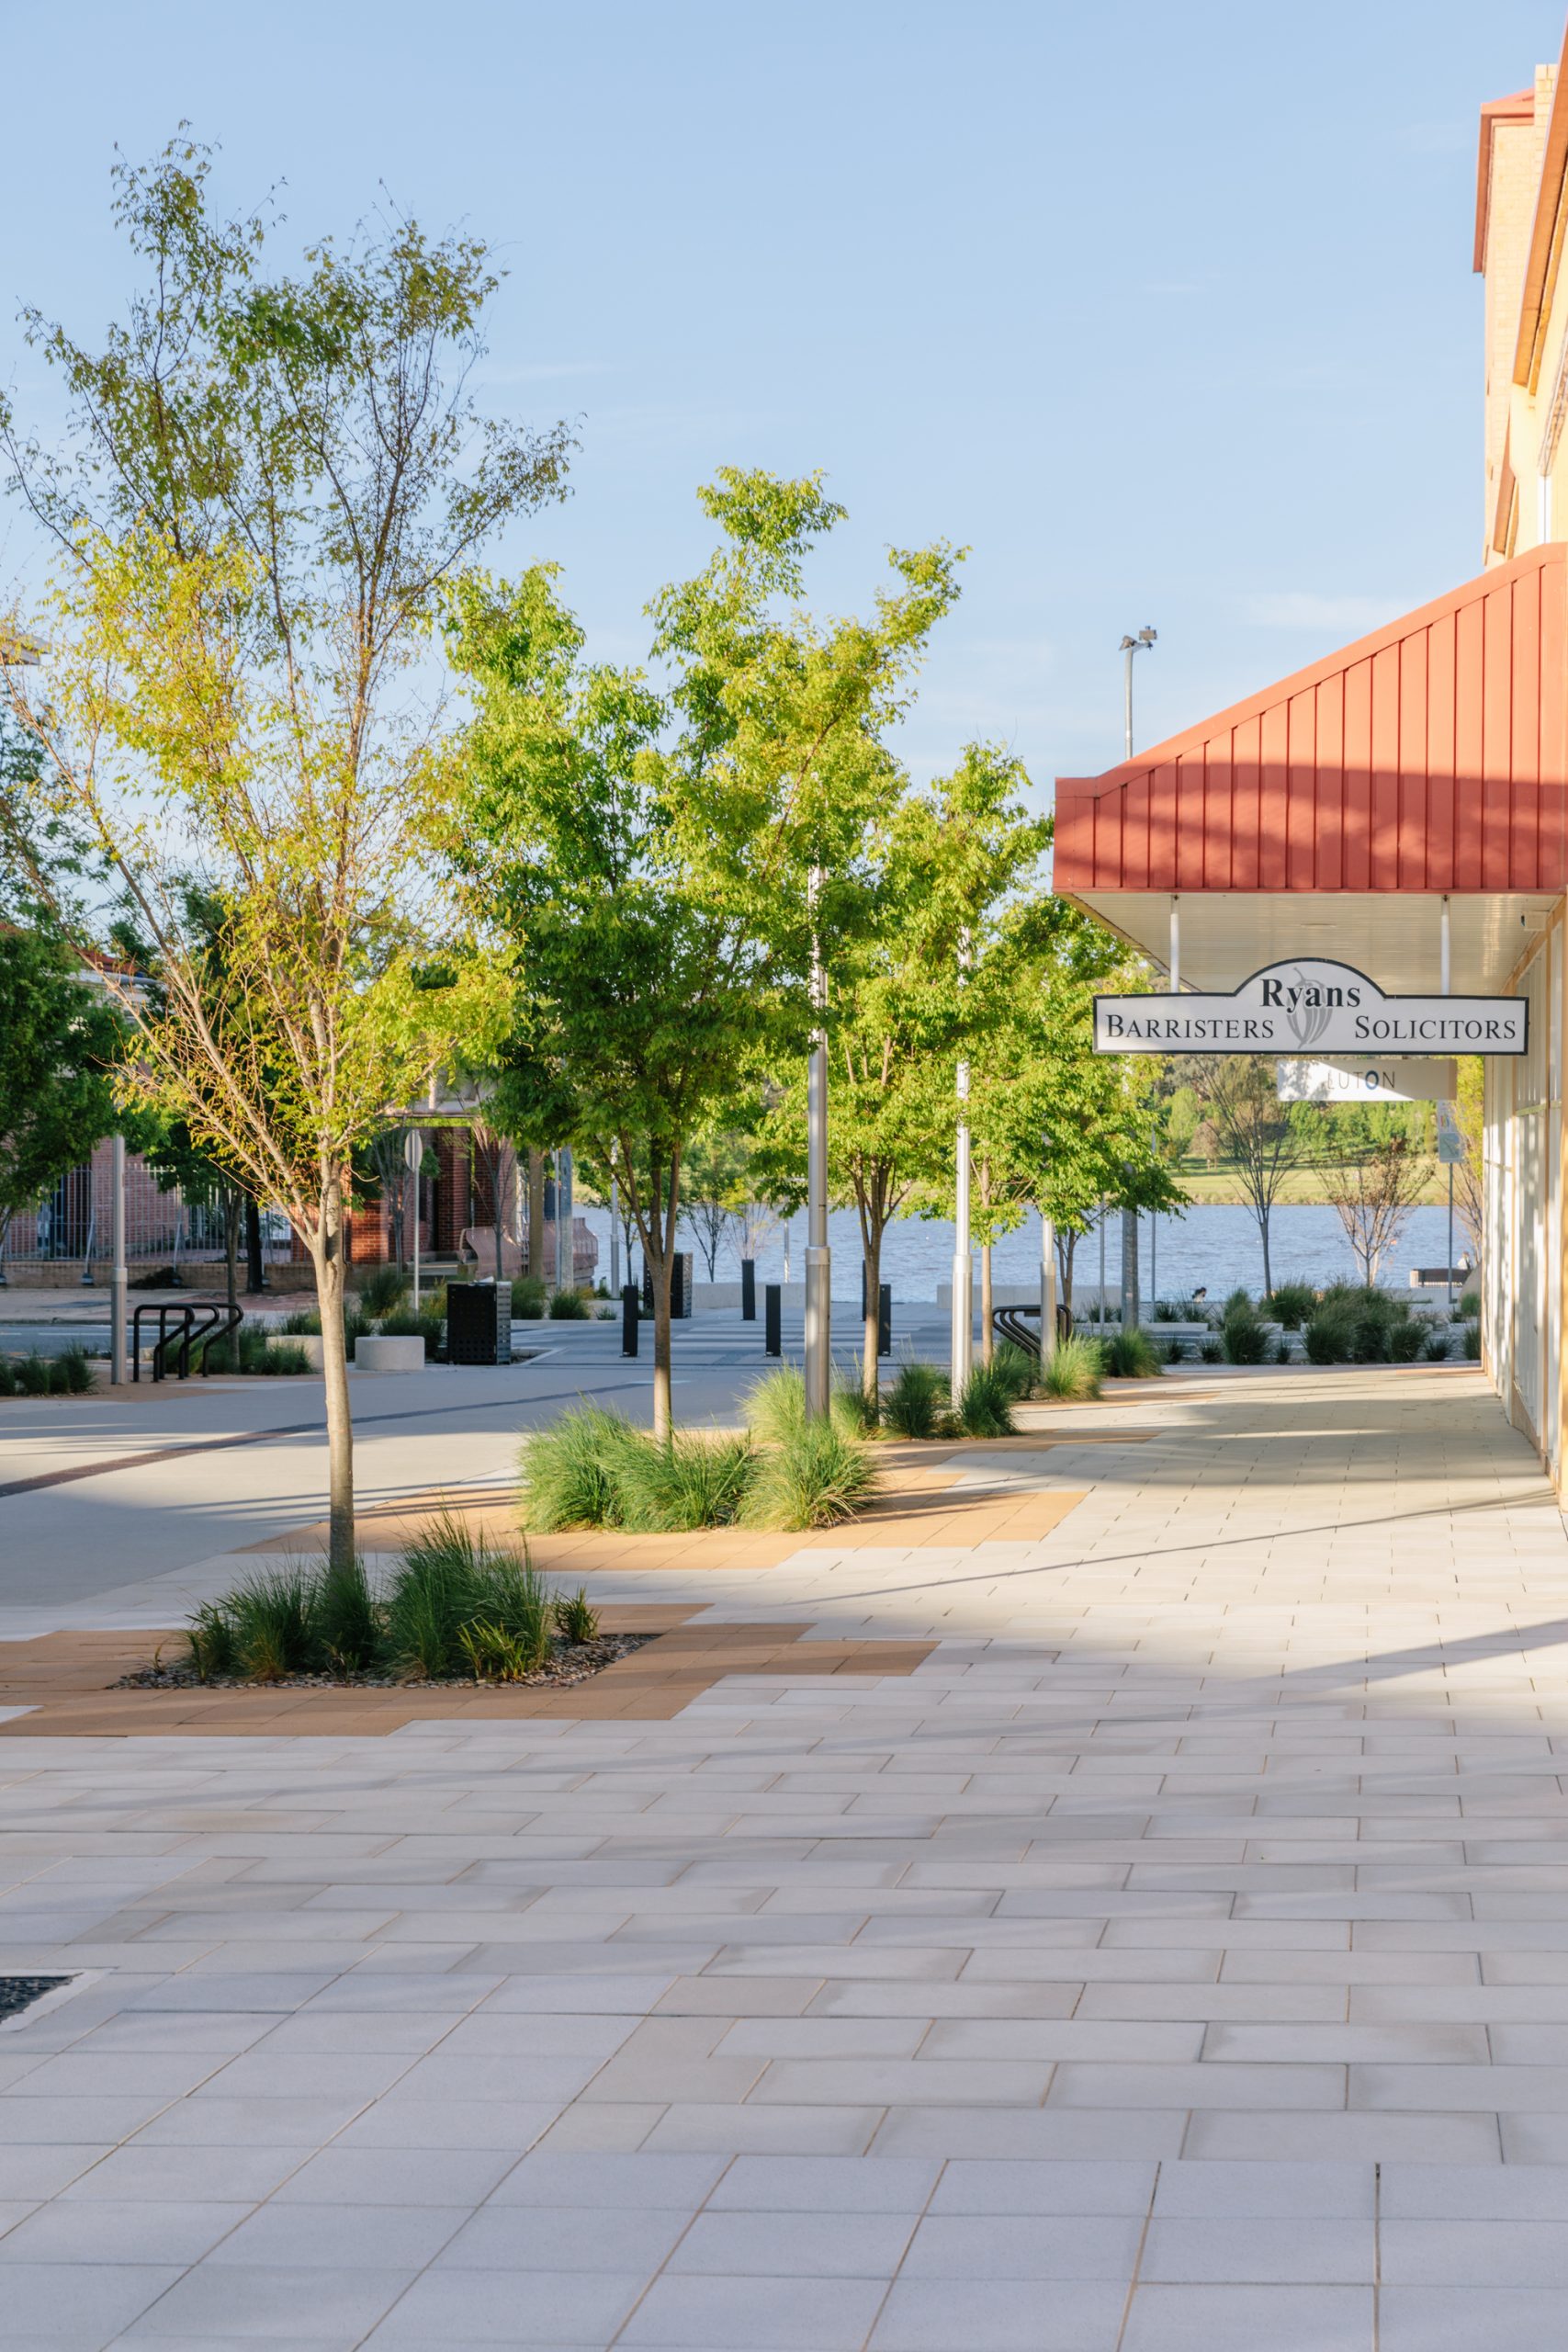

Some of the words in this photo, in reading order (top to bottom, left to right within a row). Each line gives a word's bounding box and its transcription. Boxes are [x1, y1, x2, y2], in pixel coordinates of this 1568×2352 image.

[1259, 978, 1360, 1013] Ryans
[1105, 1013, 1274, 1039] BARRISTERS
[1355, 1015, 1516, 1040] SOLICITORS
[1327, 1069, 1396, 1091] LUTON
